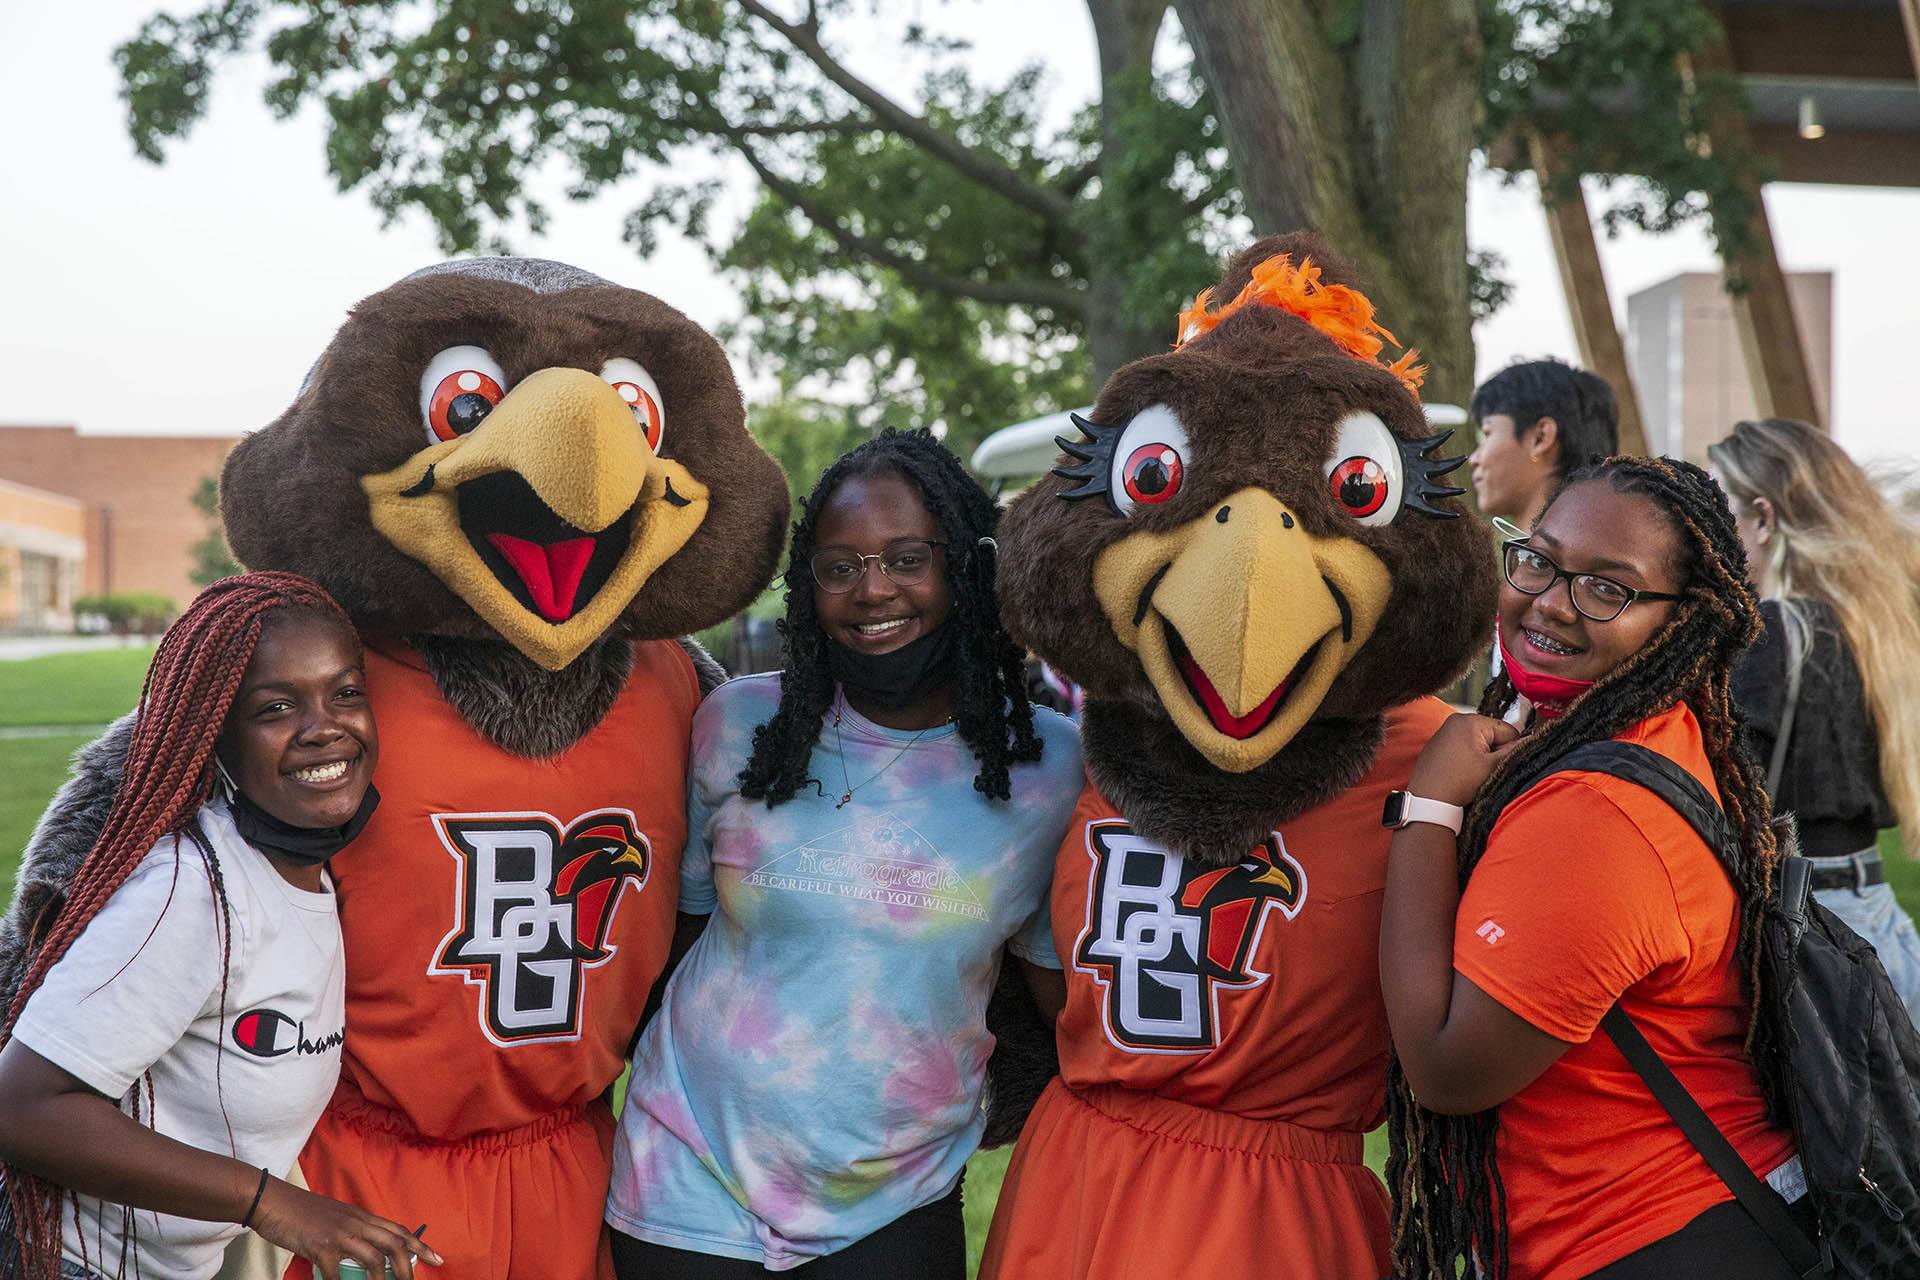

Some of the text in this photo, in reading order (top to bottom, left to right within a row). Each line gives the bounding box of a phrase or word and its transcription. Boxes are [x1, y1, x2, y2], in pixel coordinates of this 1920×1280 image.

[458, 830, 573, 1029] BG
[751, 873, 984, 918] BE CAREFUL WHAT YOU WISH FOR
[796, 847, 959, 892] Retrograde
[1088, 834, 1202, 1038] BG
